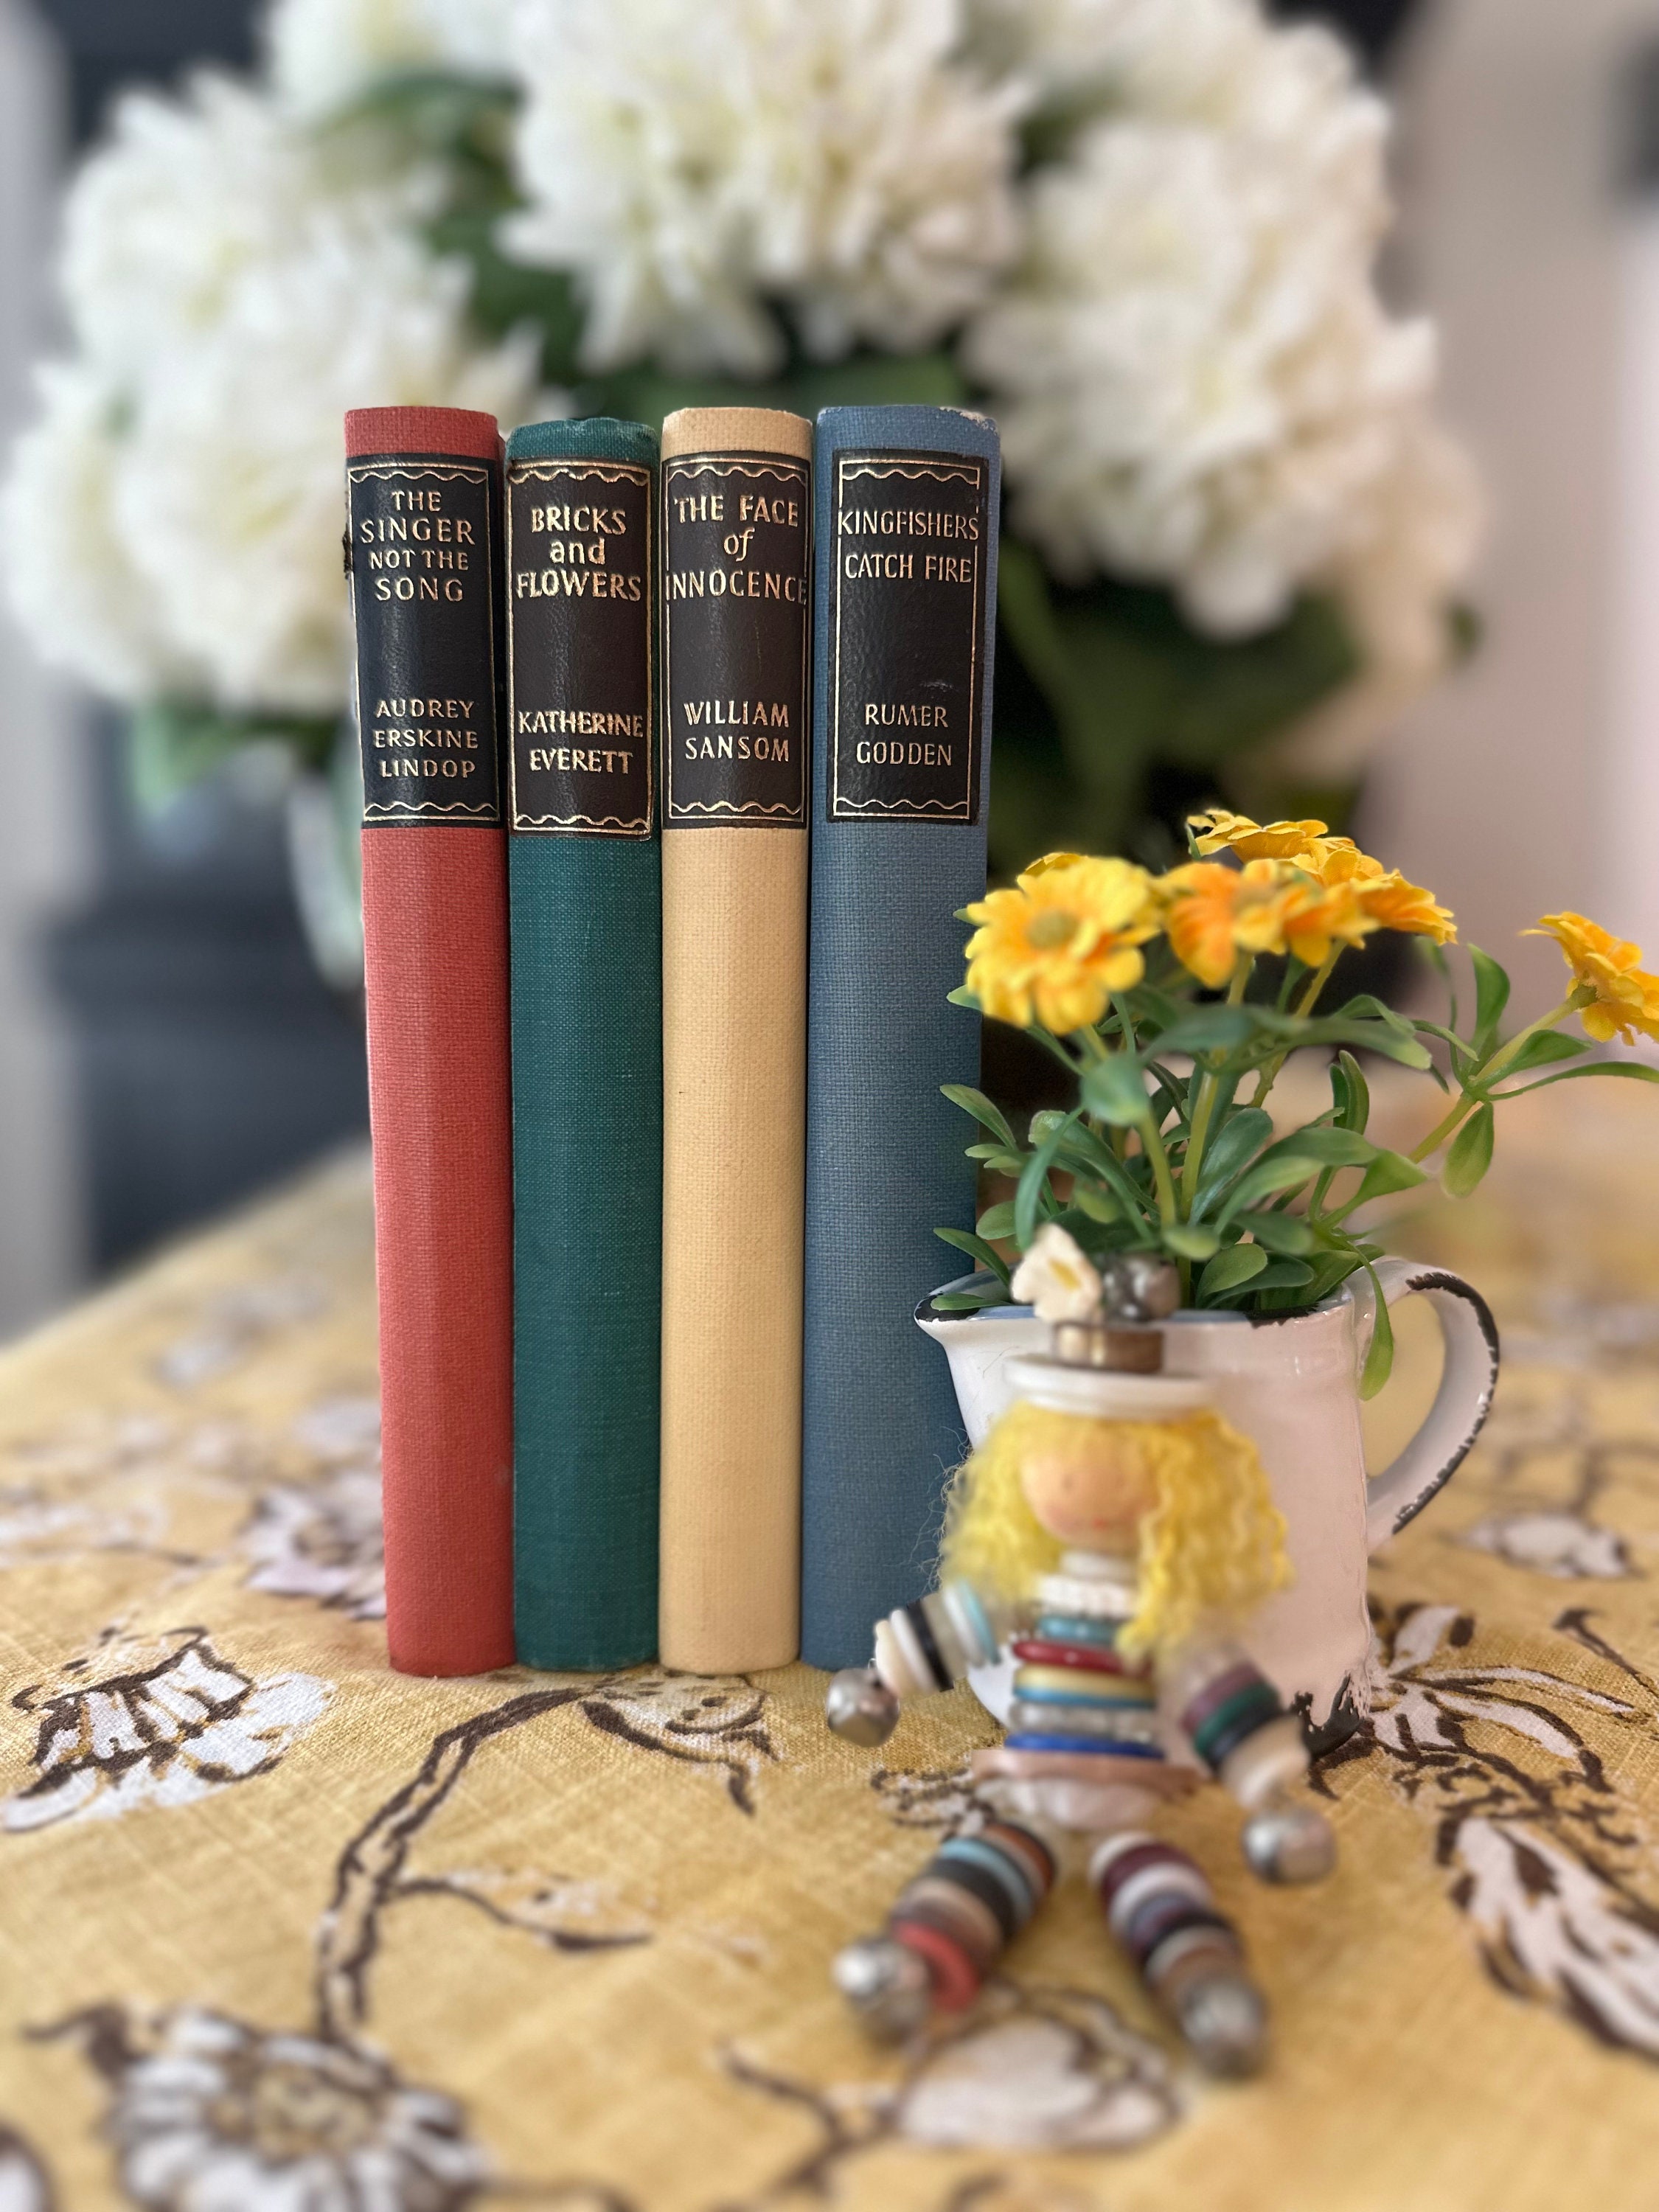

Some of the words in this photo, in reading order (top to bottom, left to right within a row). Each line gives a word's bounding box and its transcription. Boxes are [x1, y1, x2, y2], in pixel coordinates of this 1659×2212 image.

[391, 490, 442, 512] THE
[674, 495, 724, 524] THE
[740, 495, 799, 527] FACE
[360, 518, 476, 545] SINGER
[531, 505, 627, 535] BRICKS
[838, 510, 979, 540] KINGFISHERS
[550, 538, 606, 565] and
[723, 526, 755, 562] of
[370, 549, 416, 569] NOT
[421, 550, 469, 571] THE
[845, 554, 914, 579] CATCH
[925, 555, 972, 583] FIRE
[375, 577, 463, 602] SONG
[517, 569, 641, 602] FLOWERS
[666, 568, 807, 605] INNOCENCE
[375, 699, 475, 719] AUDREY
[684, 700, 789, 728] WILLIAM
[865, 703, 949, 728] RUMER
[518, 710, 644, 737] KATHERINE
[374, 728, 479, 749] ERSKINE
[685, 735, 789, 762] SANSOM
[529, 748, 633, 774] EVERETT
[856, 742, 952, 766] GODDEN
[380, 759, 476, 778] LINDOP
